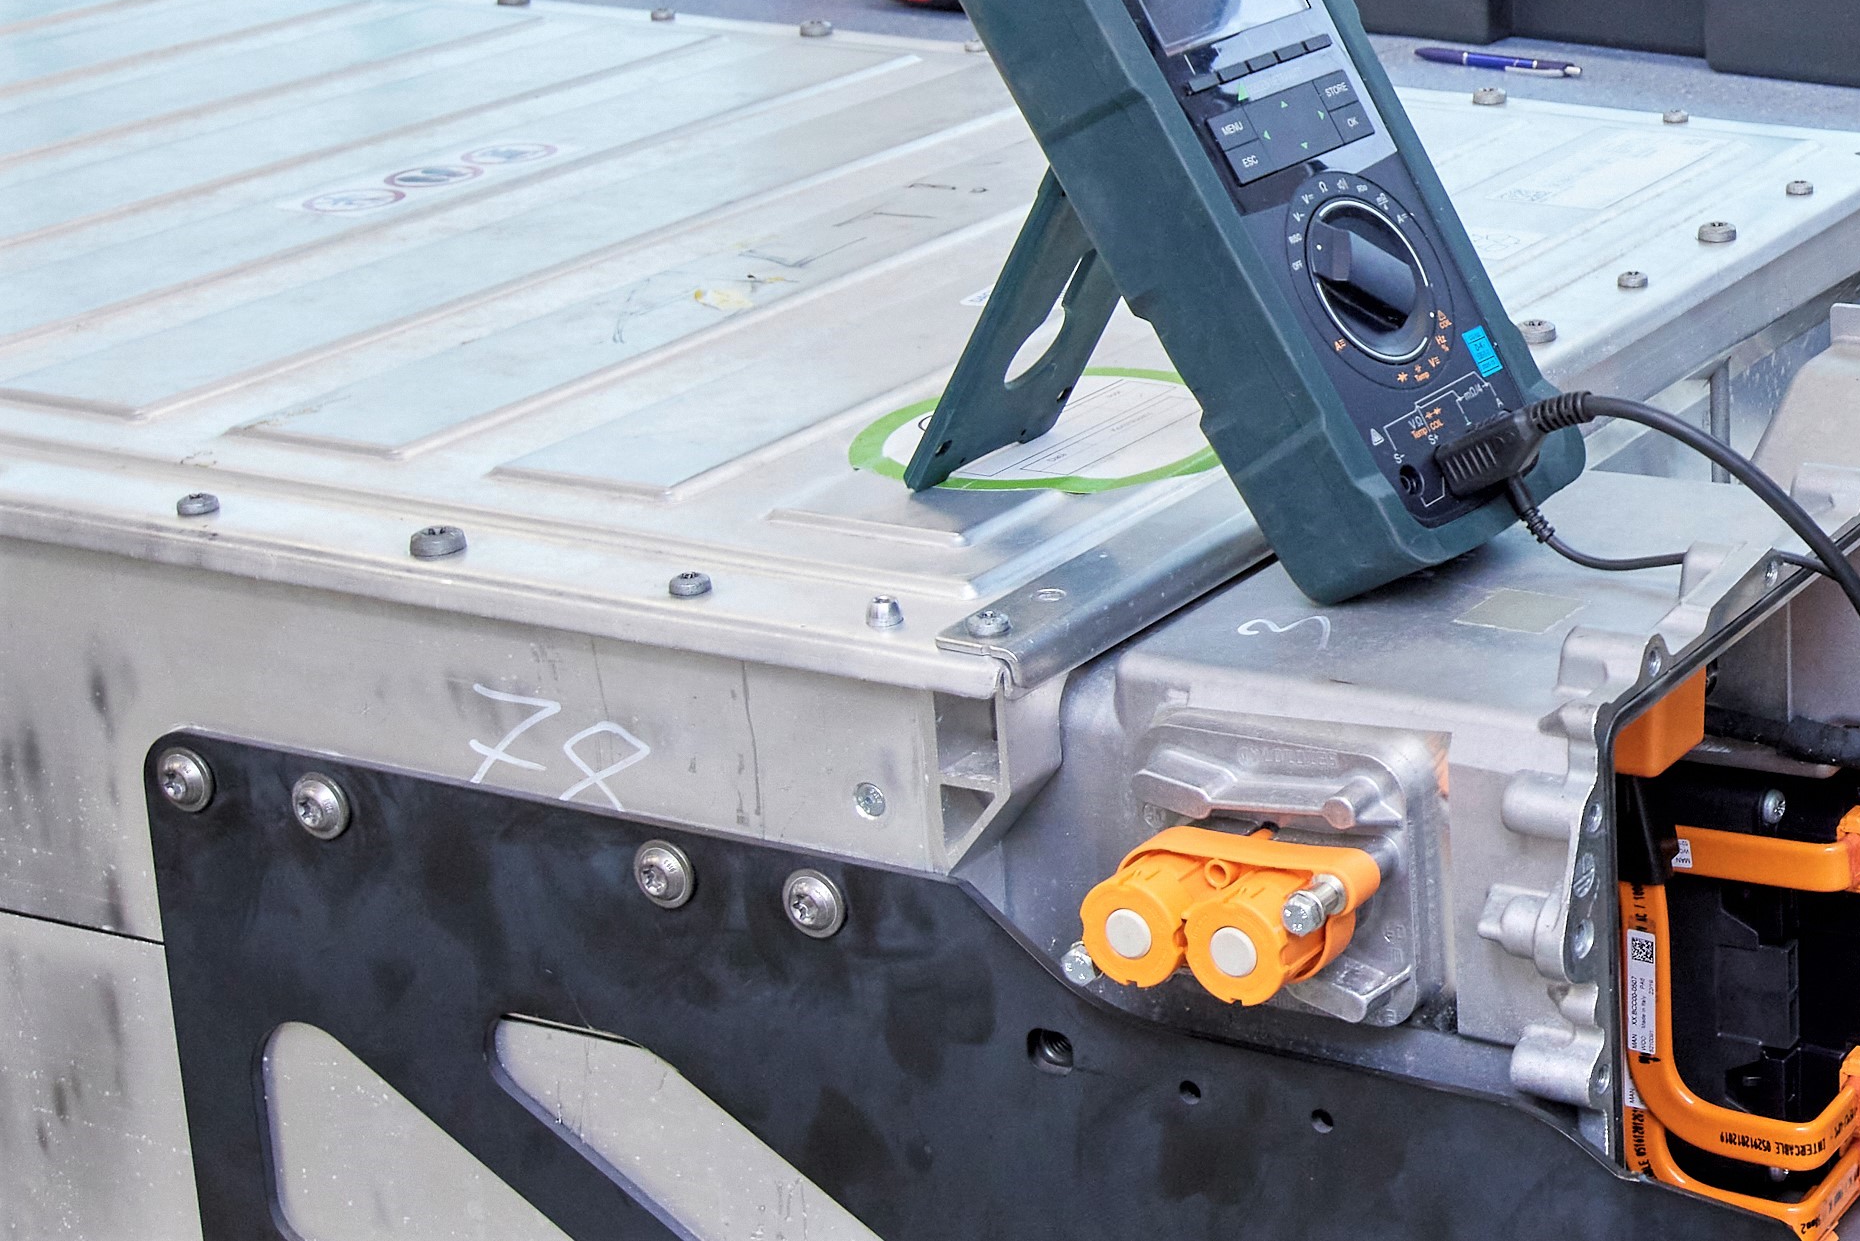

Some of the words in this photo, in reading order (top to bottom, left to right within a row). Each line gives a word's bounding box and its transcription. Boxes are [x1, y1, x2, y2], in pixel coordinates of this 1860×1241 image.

[1324, 82, 1349, 98] STORE
[1221, 121, 1244, 136] MENU
[1347, 117, 1359, 128] OK
[1242, 155, 1259, 168] ESC
[1292, 260, 1303, 271] OFF
[1434, 334, 1448, 345] Hz
[1429, 418, 1445, 431] COIL
[1411, 427, 1428, 440] Temp
[1774, 1138, 1826, 1157] INTERCABLE
